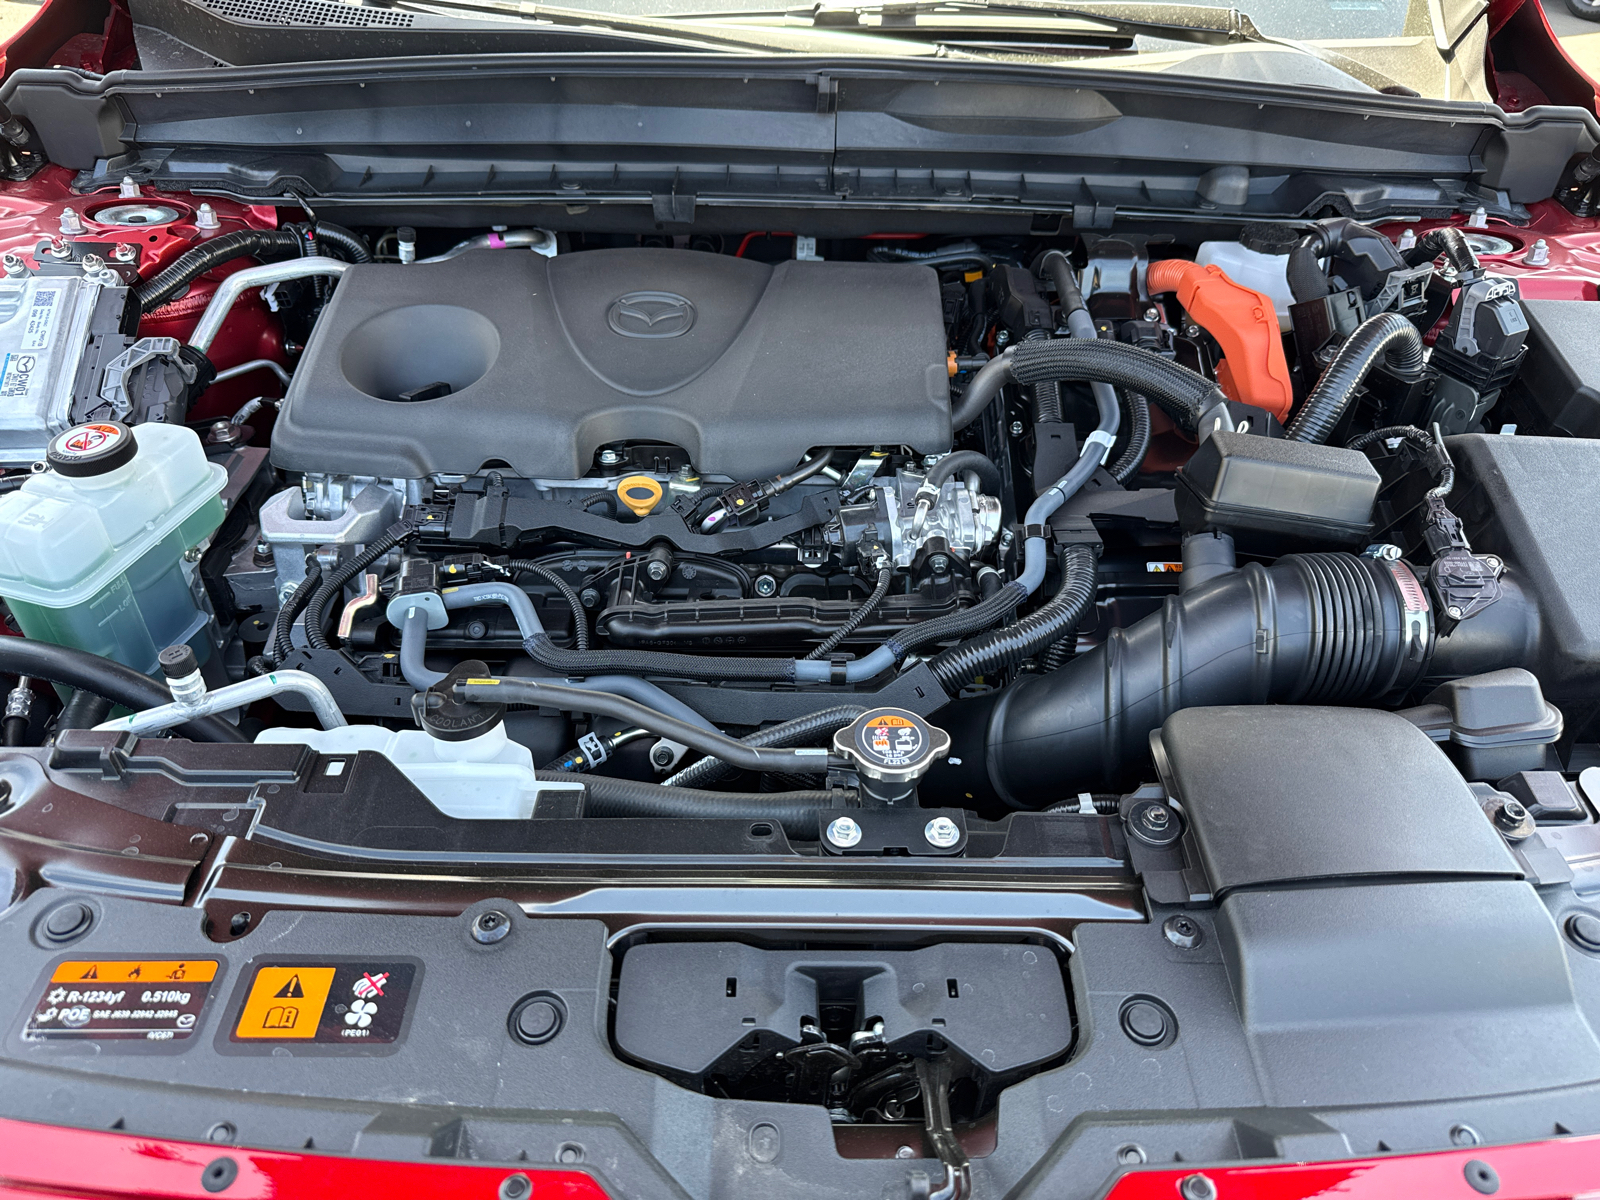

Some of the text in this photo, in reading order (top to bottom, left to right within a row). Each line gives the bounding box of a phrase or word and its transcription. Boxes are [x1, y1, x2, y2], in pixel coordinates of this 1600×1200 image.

[15, 373, 30, 396] CW01
[430, 713, 484, 728] COOLANT
[66, 990, 191, 1005] R-1234yf 0.510kg
[57, 1007, 91, 1020] POE
[92, 1009, 112, 1019] SAE
[341, 1029, 370, 1037] (PE01)
